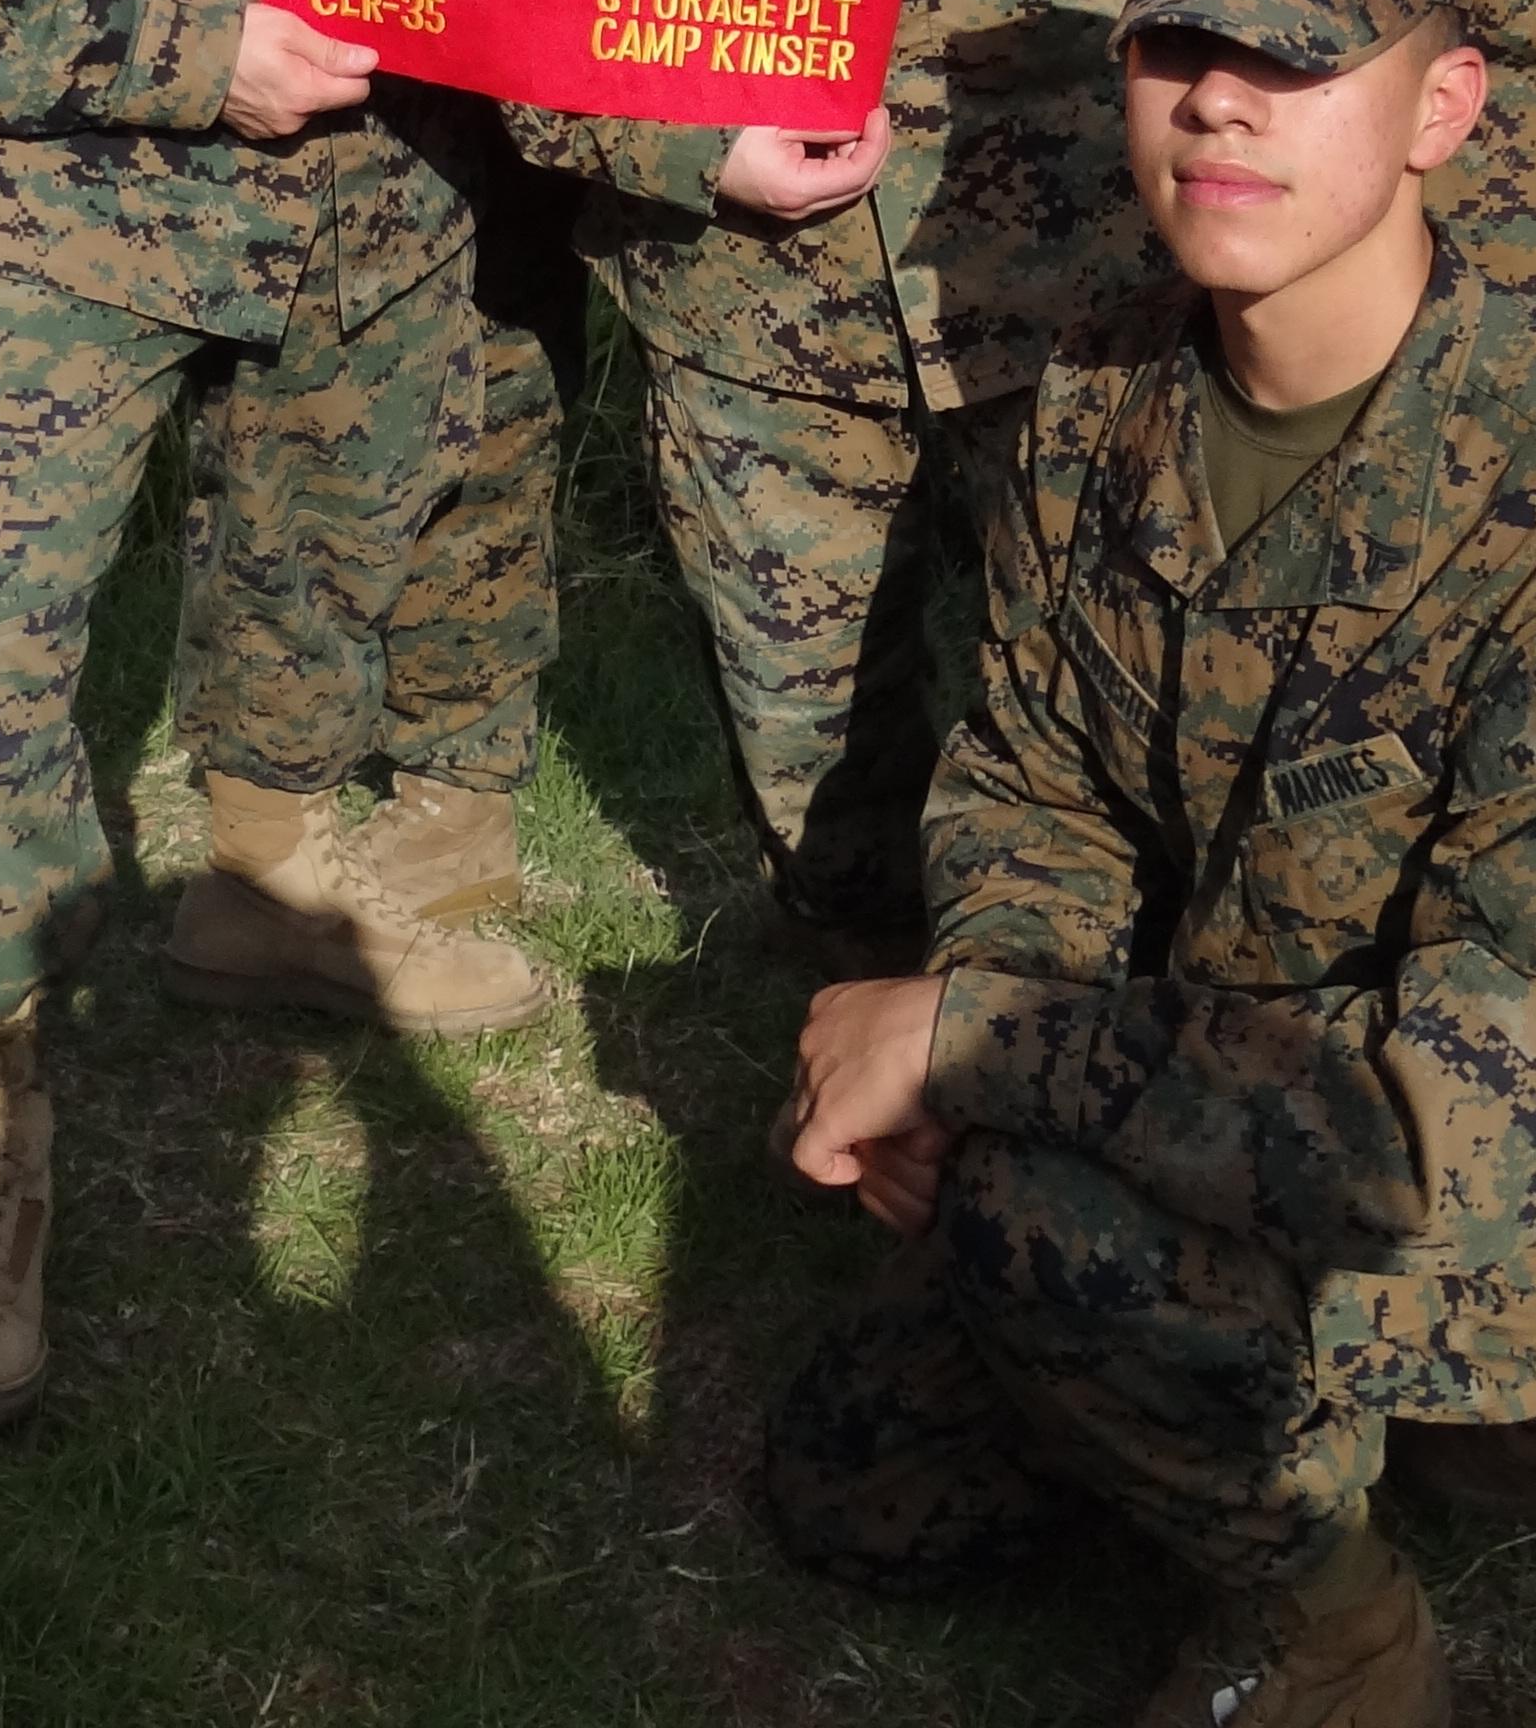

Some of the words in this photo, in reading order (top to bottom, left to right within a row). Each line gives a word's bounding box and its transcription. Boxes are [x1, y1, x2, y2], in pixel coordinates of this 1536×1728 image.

[591, 16, 703, 68] CAMP
[709, 29, 856, 82] KINSER
[1271, 748, 1390, 819] MARINES
